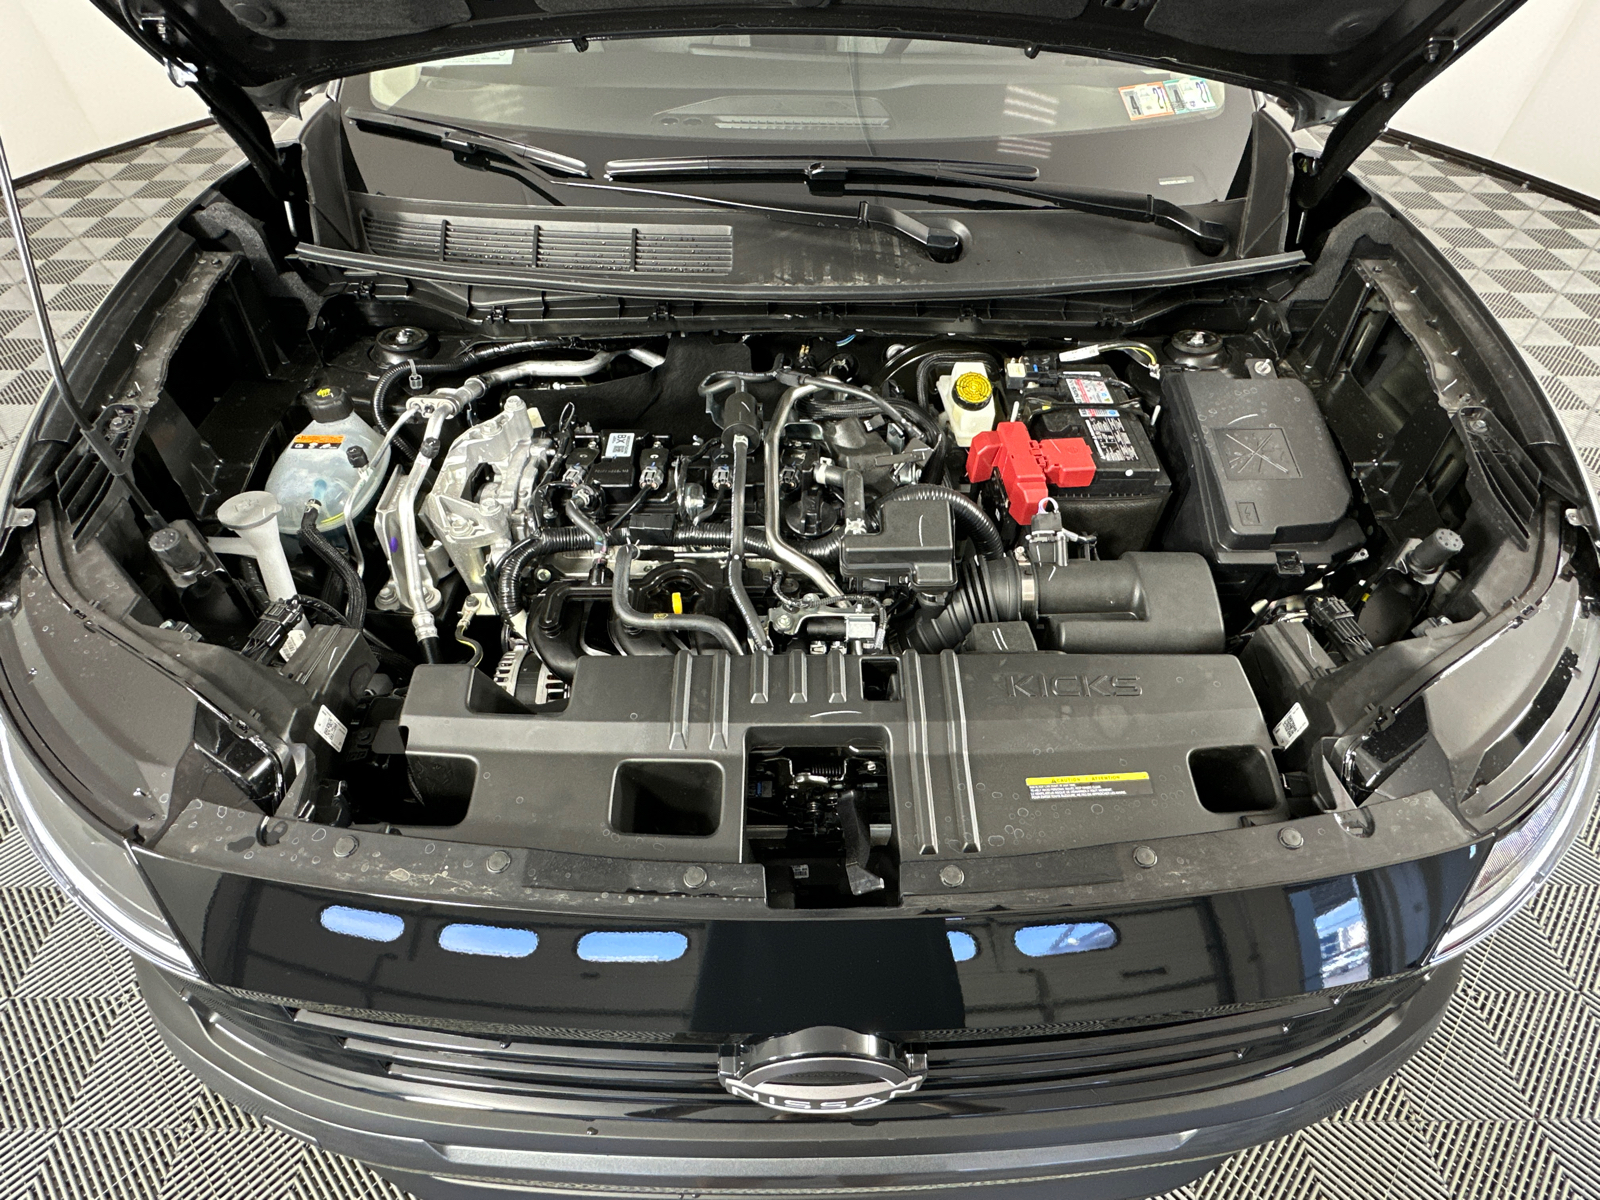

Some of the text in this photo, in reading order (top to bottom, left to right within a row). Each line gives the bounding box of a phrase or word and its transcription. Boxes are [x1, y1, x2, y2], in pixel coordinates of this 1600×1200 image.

[1129, 95, 1142, 115] 4
[616, 435, 626, 444] BX
[1007, 674, 1143, 697] KICKS
[731, 1083, 918, 1110] NISSAN
